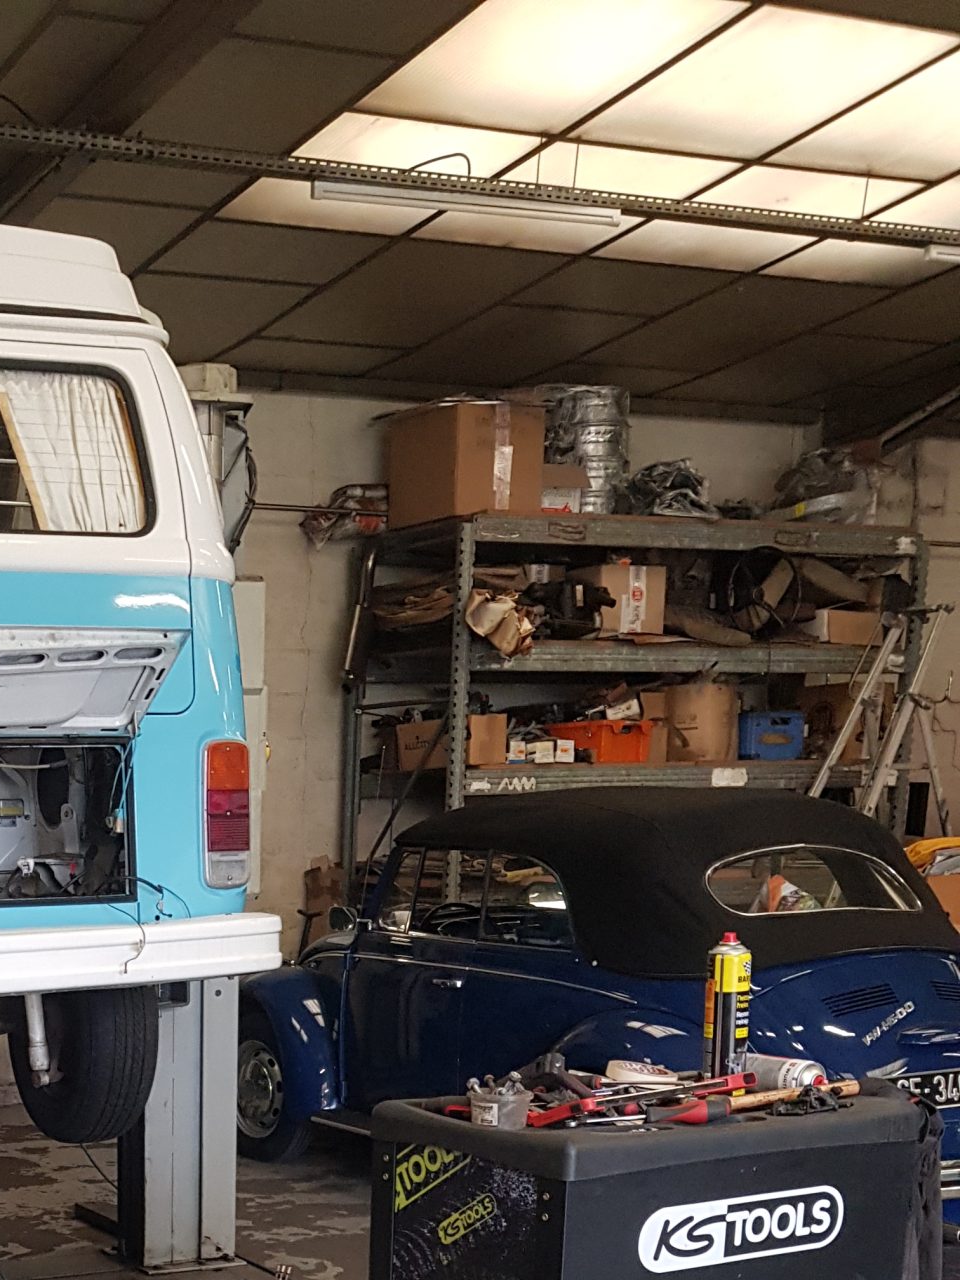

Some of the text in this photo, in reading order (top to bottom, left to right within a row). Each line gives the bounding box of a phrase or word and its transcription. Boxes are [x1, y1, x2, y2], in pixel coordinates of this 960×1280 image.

[396, 1146, 460, 1191] TOOL
[460, 1198, 493, 1227] TOOLS
[653, 1198, 831, 1262] KS TOOLS
